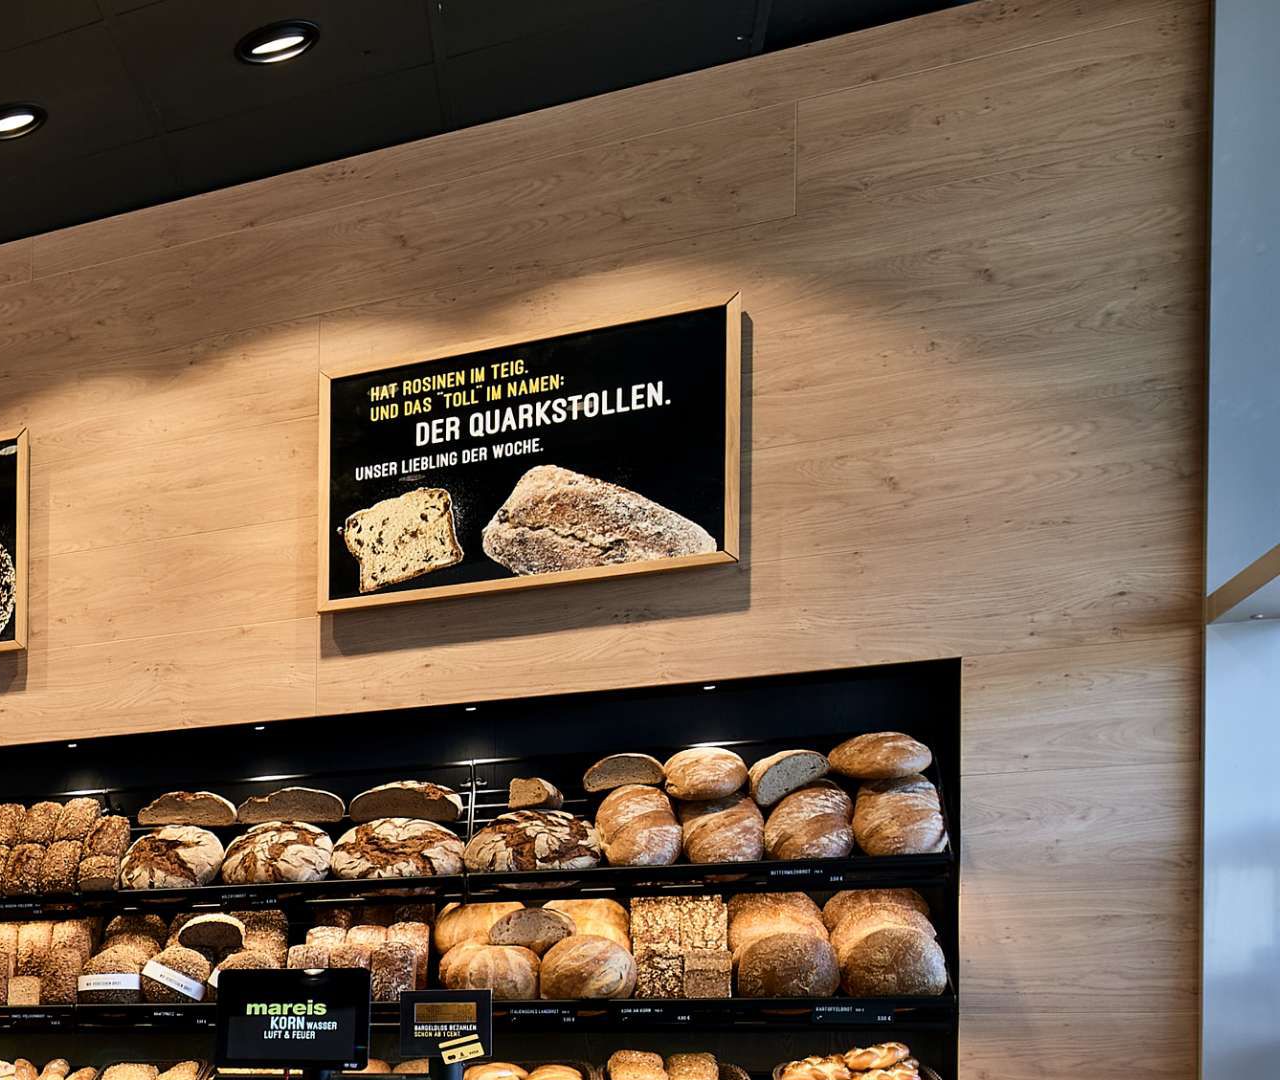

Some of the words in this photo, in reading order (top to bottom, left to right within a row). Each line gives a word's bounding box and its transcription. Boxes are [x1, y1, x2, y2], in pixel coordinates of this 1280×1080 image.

[370, 382, 397, 402] HAT
[402, 371, 466, 397] ROSINEN
[470, 367, 485, 384] IM
[491, 359, 529, 379] TEIG.
[370, 403, 399, 422] UND
[403, 397, 432, 416] DAS
[486, 383, 501, 400] IM
[506, 374, 564, 398] NAMEN:
[415, 418, 460, 447] DER
[469, 381, 671, 438] QUARKSTOLLEN.
[355, 462, 397, 482] UNSER
[401, 451, 458, 474] LIEBLING
[461, 446, 488, 465] DER
[492, 437, 544, 459] WOCHE.
[246, 999, 327, 1016] mareis
[270, 1016, 305, 1030] KORN
[306, 1021, 337, 1030] WASSER
[263, 1030, 283, 1039] LUFT
[284, 1031, 290, 1039] &
[292, 1030, 316, 1039] FEUER
